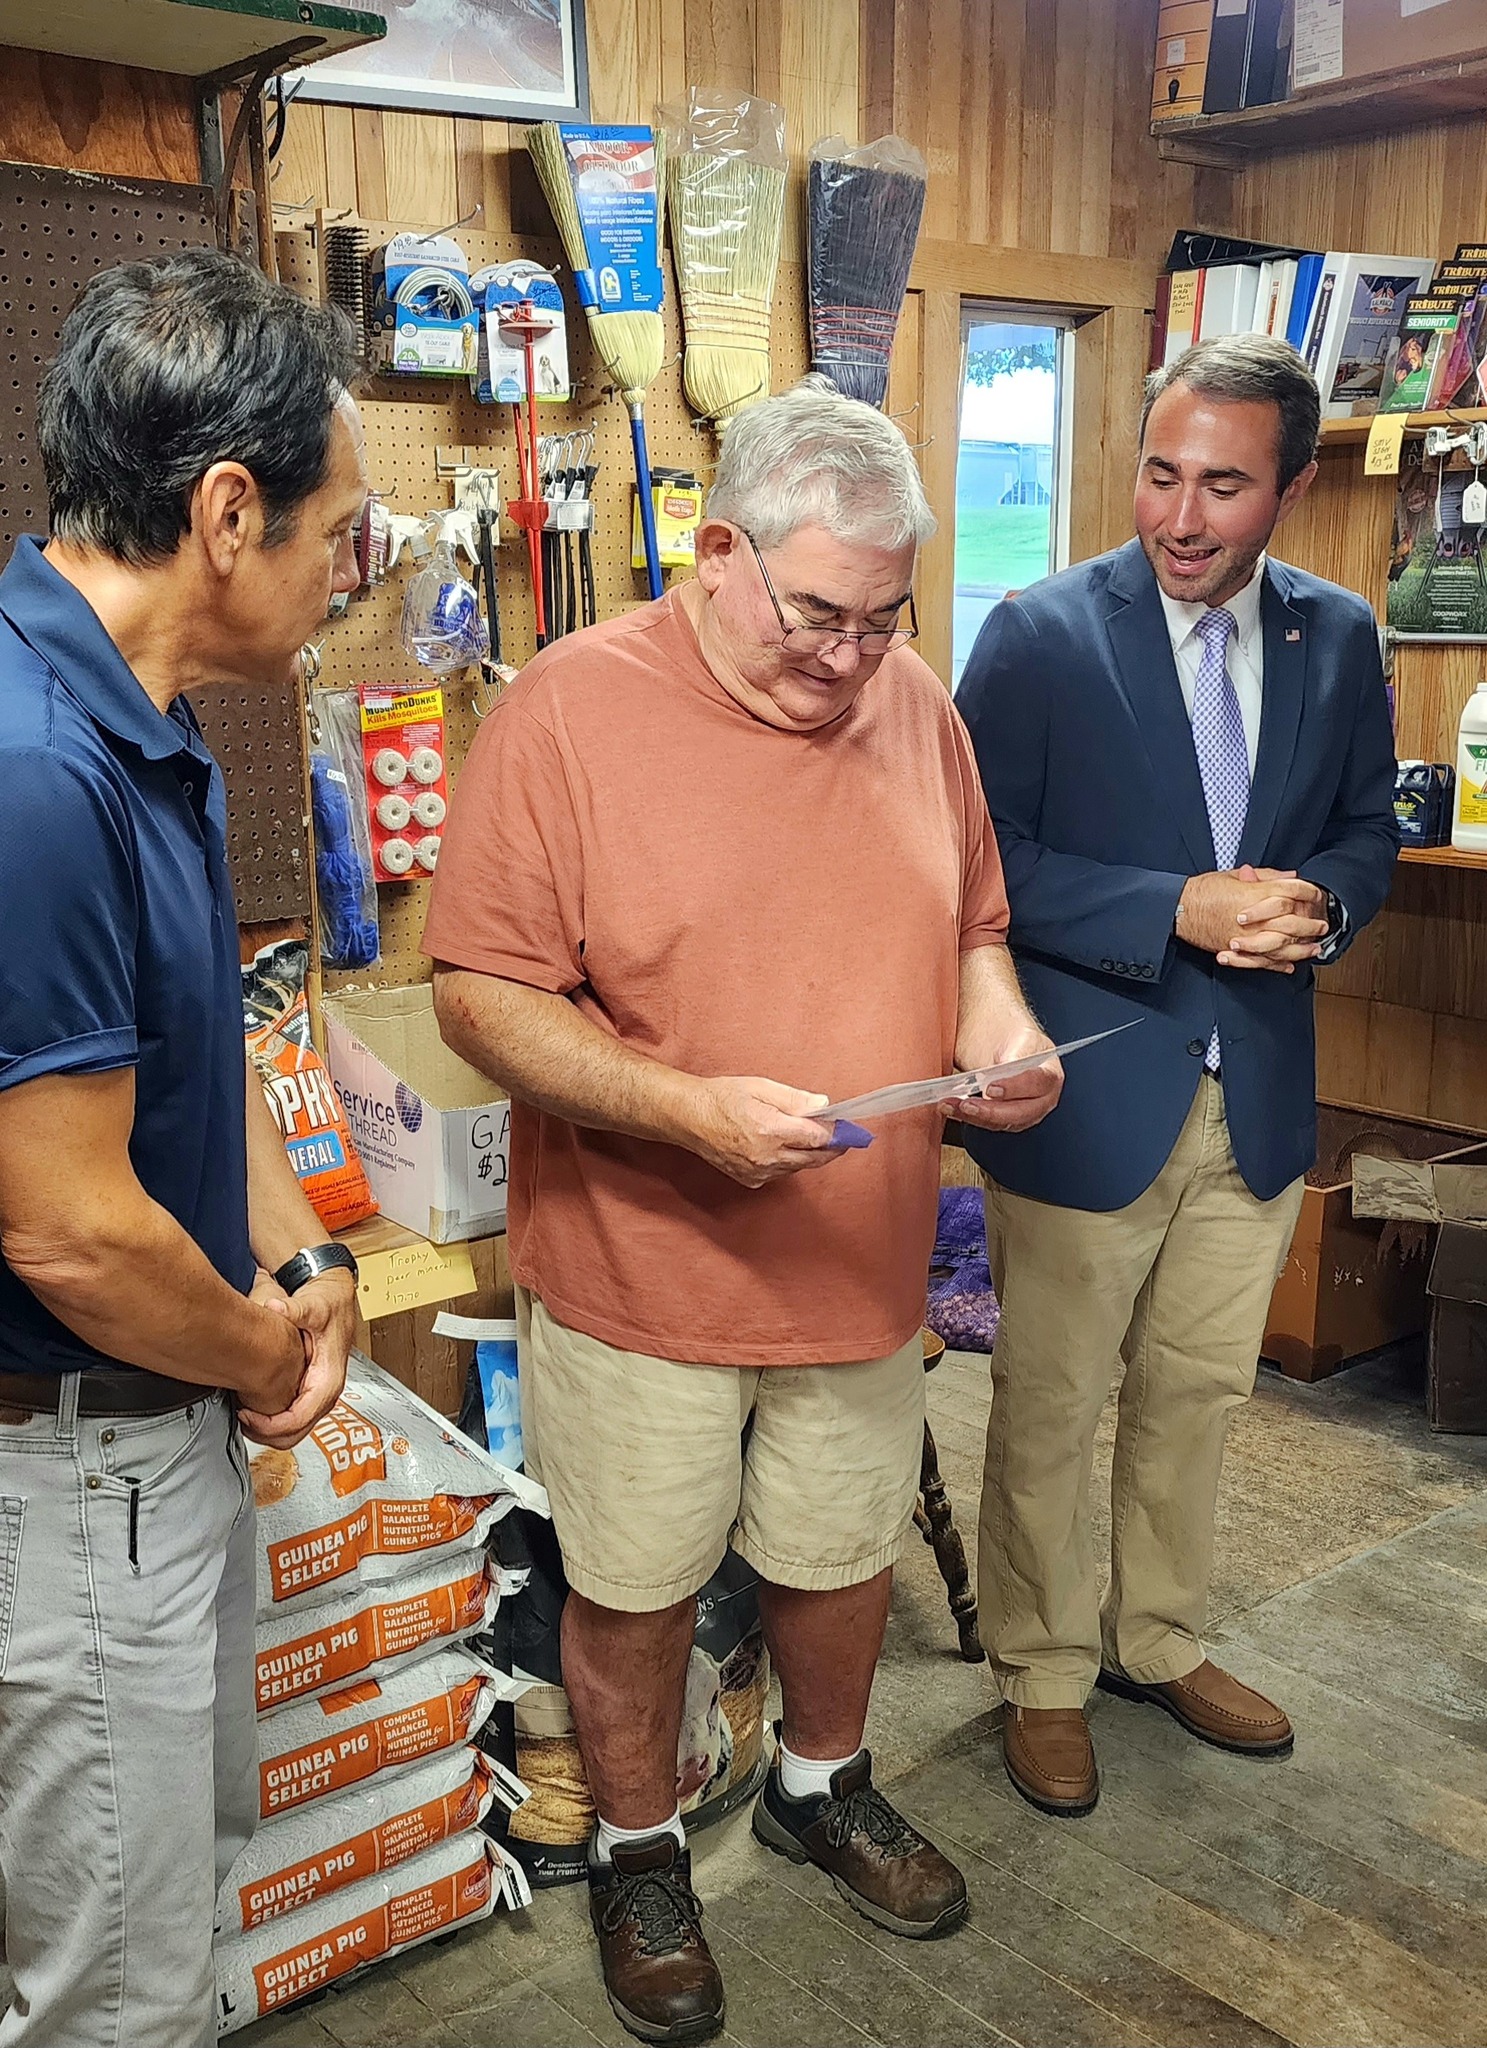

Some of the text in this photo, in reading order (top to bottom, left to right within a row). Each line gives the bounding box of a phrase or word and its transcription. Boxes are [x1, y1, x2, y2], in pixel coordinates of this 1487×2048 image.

[582, 160, 639, 172] OUTDOOR
[1432, 284, 1478, 295] TRIBUTE
[1408, 299, 1456, 310] TRIBUTE
[1407, 318, 1451, 327] SENIORITY
[366, 714, 388, 724] Kills
[388, 704, 438, 720] Mosquitoes
[334, 1080, 396, 1126] Service
[348, 1113, 397, 1147] THREAD
[471, 1110, 511, 1150] GA
[388, 1251, 429, 1268] Trophy
[418, 1259, 452, 1277] mineral
[382, 1504, 430, 1513] COMPLETE
[382, 1514, 430, 1524] BALANCED
[383, 1520, 448, 1534] NUTRITION for
[384, 1530, 442, 1546] GUINEA PIGS
[278, 1514, 368, 1570] GUINEA PIG
[280, 1551, 341, 1590] SELECT
[382, 1598, 428, 1618] COMPLETE
[384, 1610, 430, 1629] BALANCED
[385, 1616, 446, 1640] NUTRITION for
[386, 1628, 440, 1650] GUINEA PIGS
[257, 1628, 359, 1682] GUINEA PIG
[259, 1662, 324, 1702] SELECT
[383, 1707, 427, 1728] COMPLETE
[386, 1719, 428, 1740] BALANCED
[386, 1736, 439, 1760] GUINEA PIGS
[387, 1725, 446, 1750] NUTRITION for
[266, 1734, 370, 1788] GUINEA PIG
[268, 1769, 332, 1808] SELECT
[382, 1812, 424, 1836] COMPLETE
[384, 1822, 424, 1848] BALANCED
[384, 1837, 434, 1866] GUINEA PIGS
[385, 1826, 440, 1858] NUTRITION for
[548, 1860, 584, 1869] Designed
[556, 1868, 578, 1876] Profit
[250, 1850, 356, 1910] GUINEA PIG
[250, 1888, 316, 1926] SELECT
[390, 1889, 432, 1910] COMPLETE
[392, 1900, 433, 1921] BALANCED
[391, 1914, 442, 1940] GUINEA PIGS
[393, 1902, 448, 1929] NUTRITION for
[263, 1926, 367, 1989] GUINEA PIG
[265, 1964, 329, 2006] SELECT
